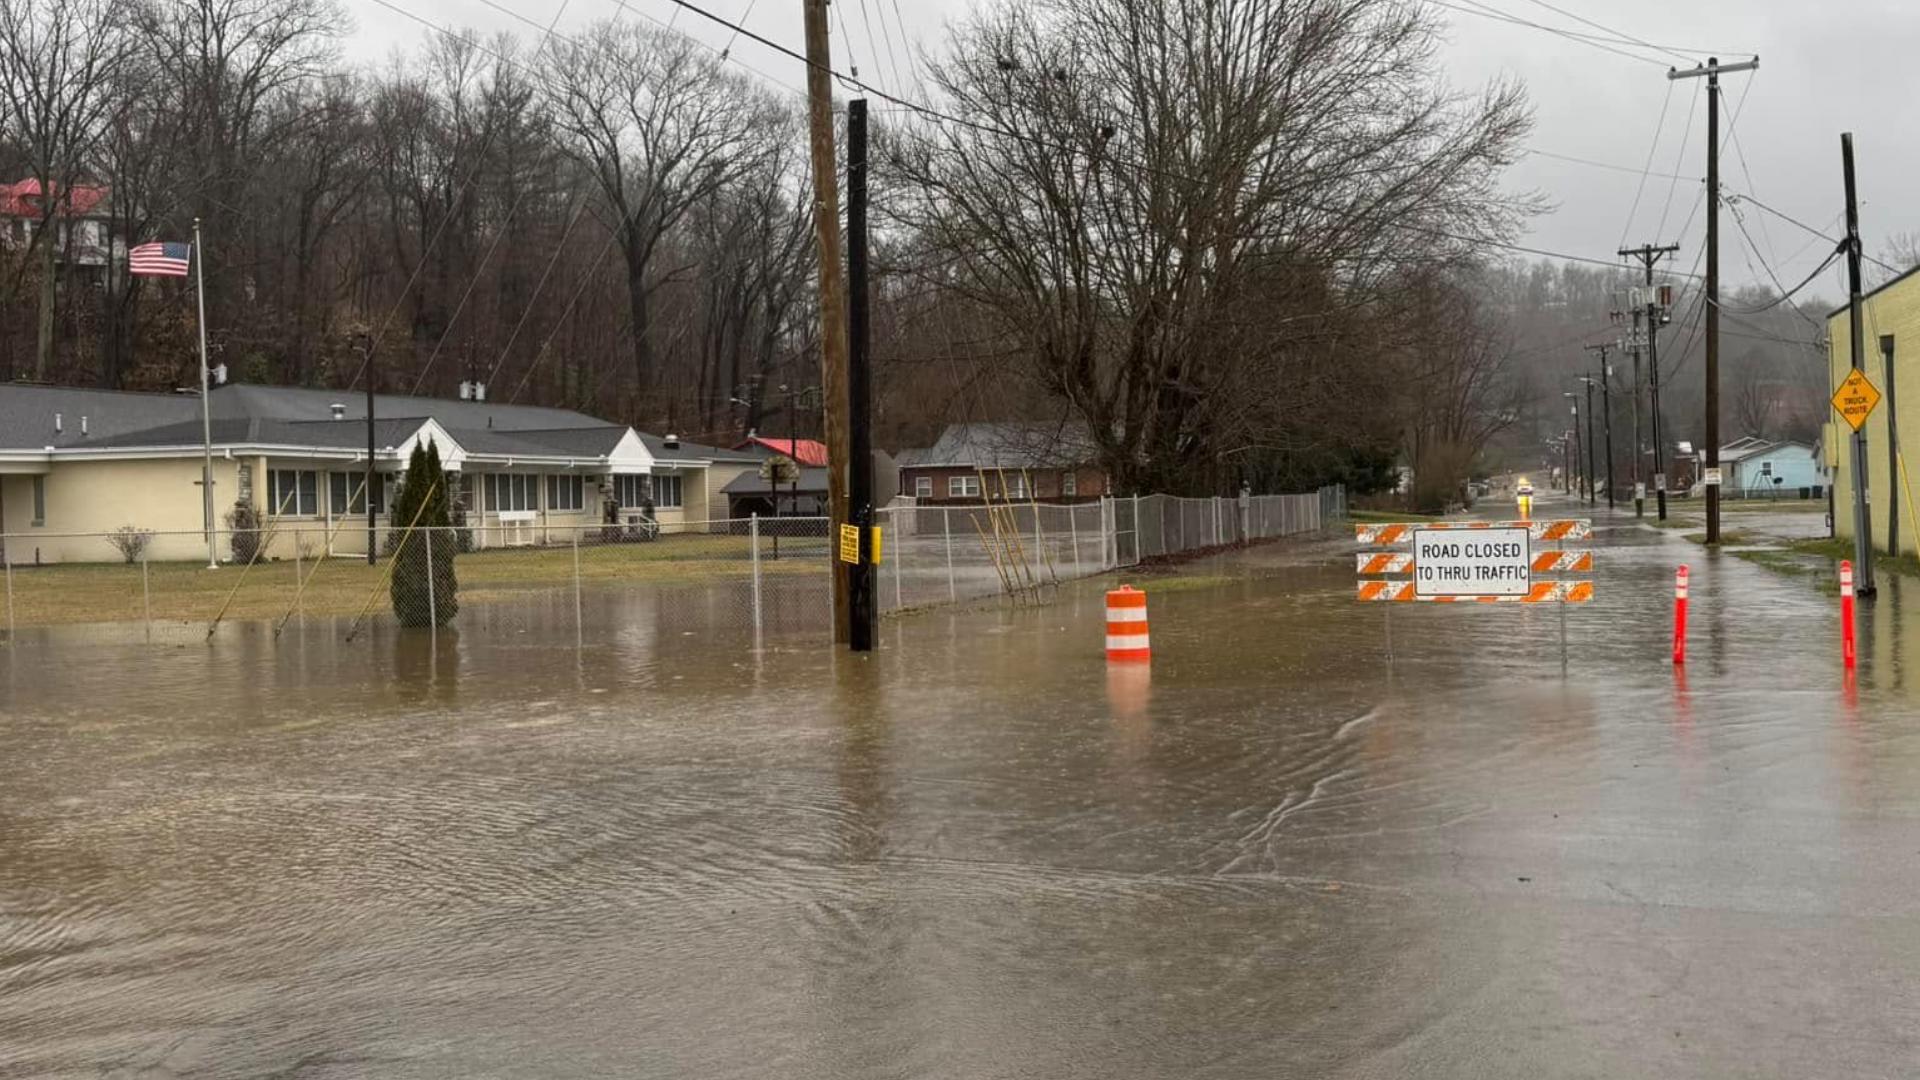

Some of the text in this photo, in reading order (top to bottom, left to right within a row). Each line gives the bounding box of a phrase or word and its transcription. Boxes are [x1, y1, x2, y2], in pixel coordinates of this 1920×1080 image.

[1844, 397, 1867, 405] TRUCK
[1844, 406, 1867, 415] ROUTE
[1422, 543, 1521, 558] ROAD CLOSED
[1417, 565, 1528, 580] TO THRU TRAFFIC
